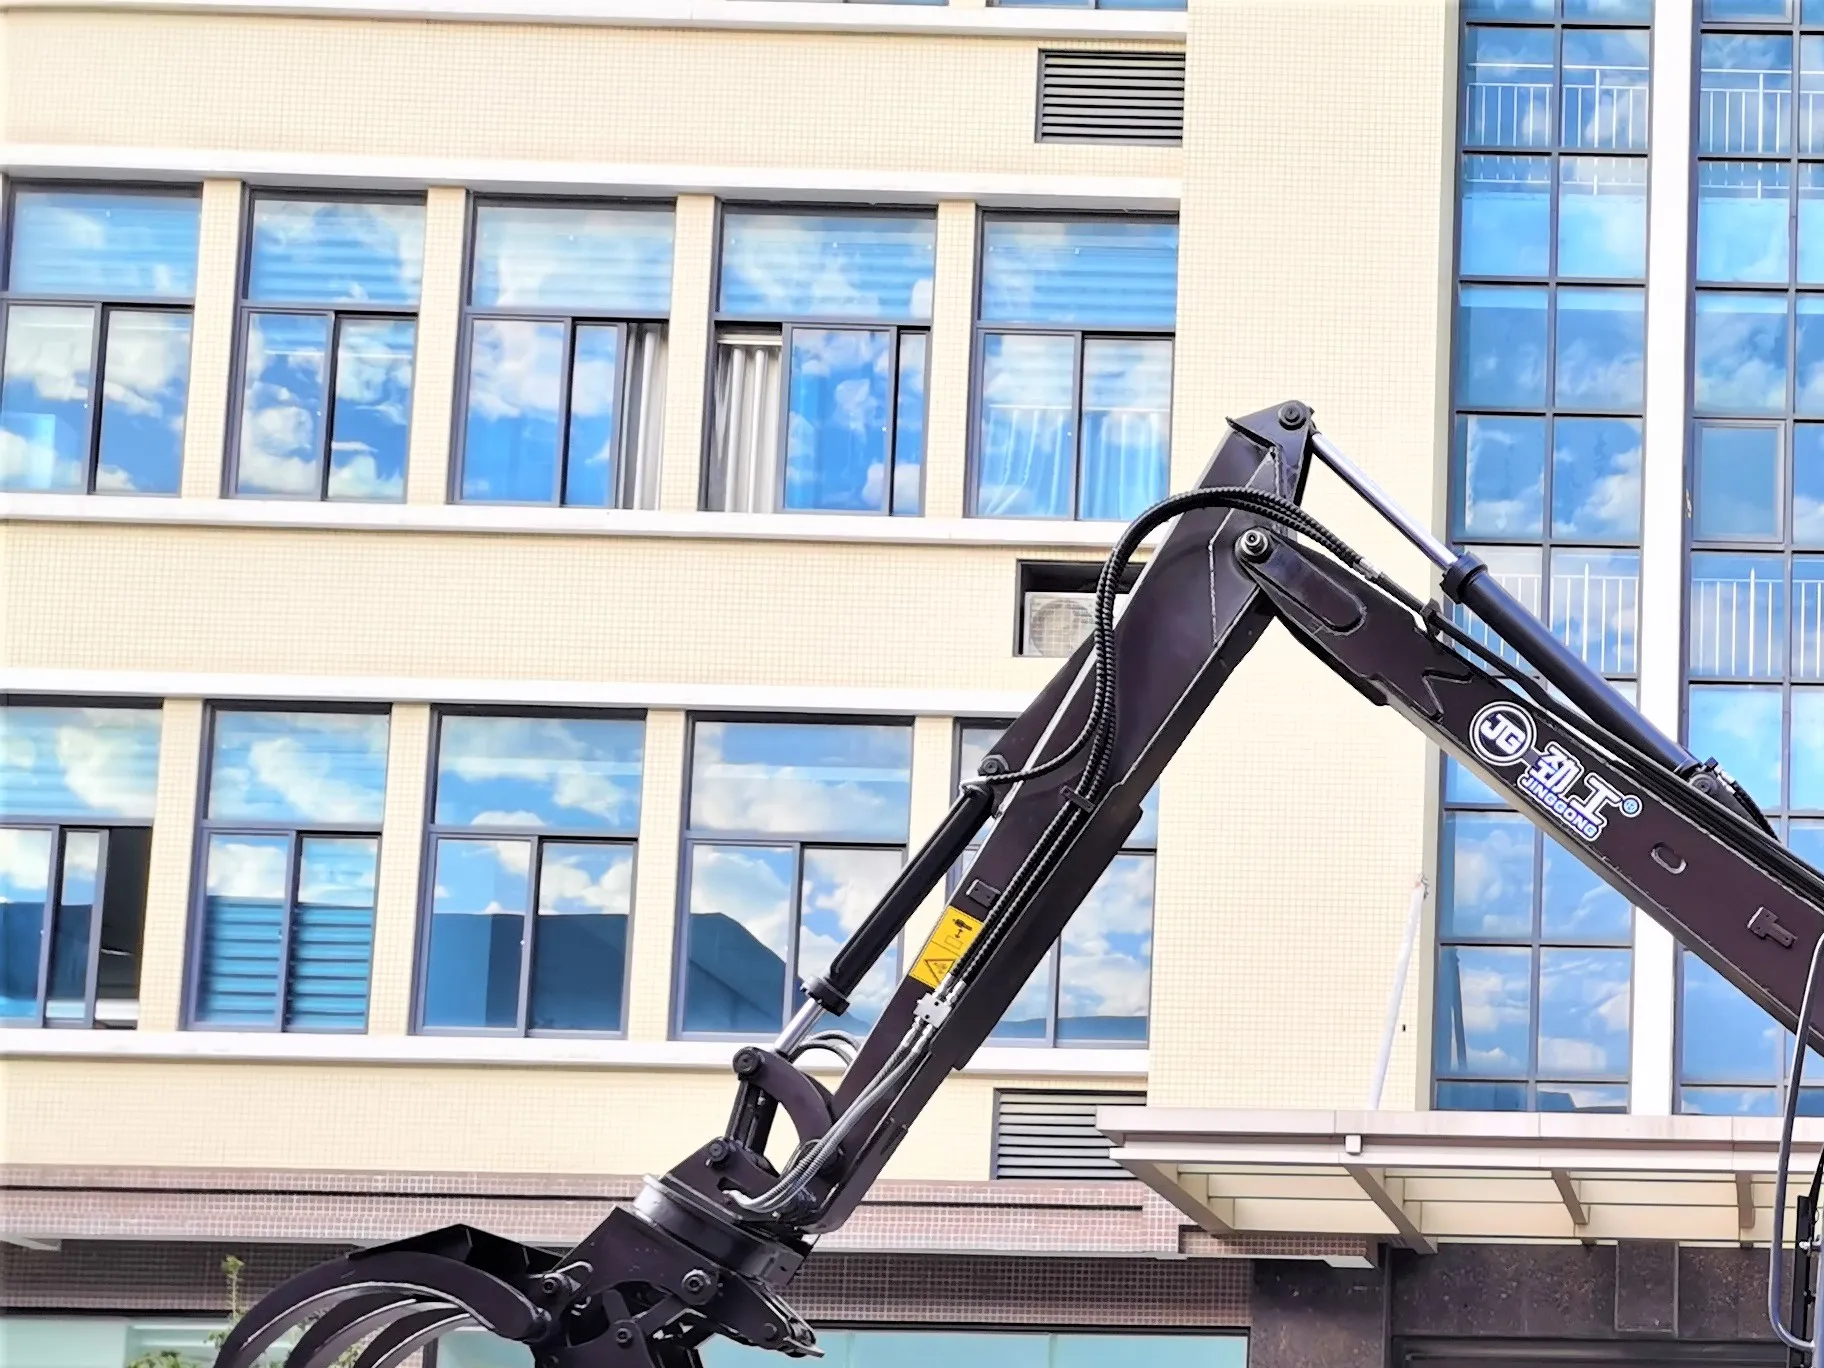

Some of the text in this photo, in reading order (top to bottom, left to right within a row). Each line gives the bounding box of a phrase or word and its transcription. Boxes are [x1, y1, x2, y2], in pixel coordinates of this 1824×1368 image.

[1480, 712, 1527, 755] JG
[1521, 776, 1601, 839] JINGGONG
[1528, 744, 1622, 826] 劲工
